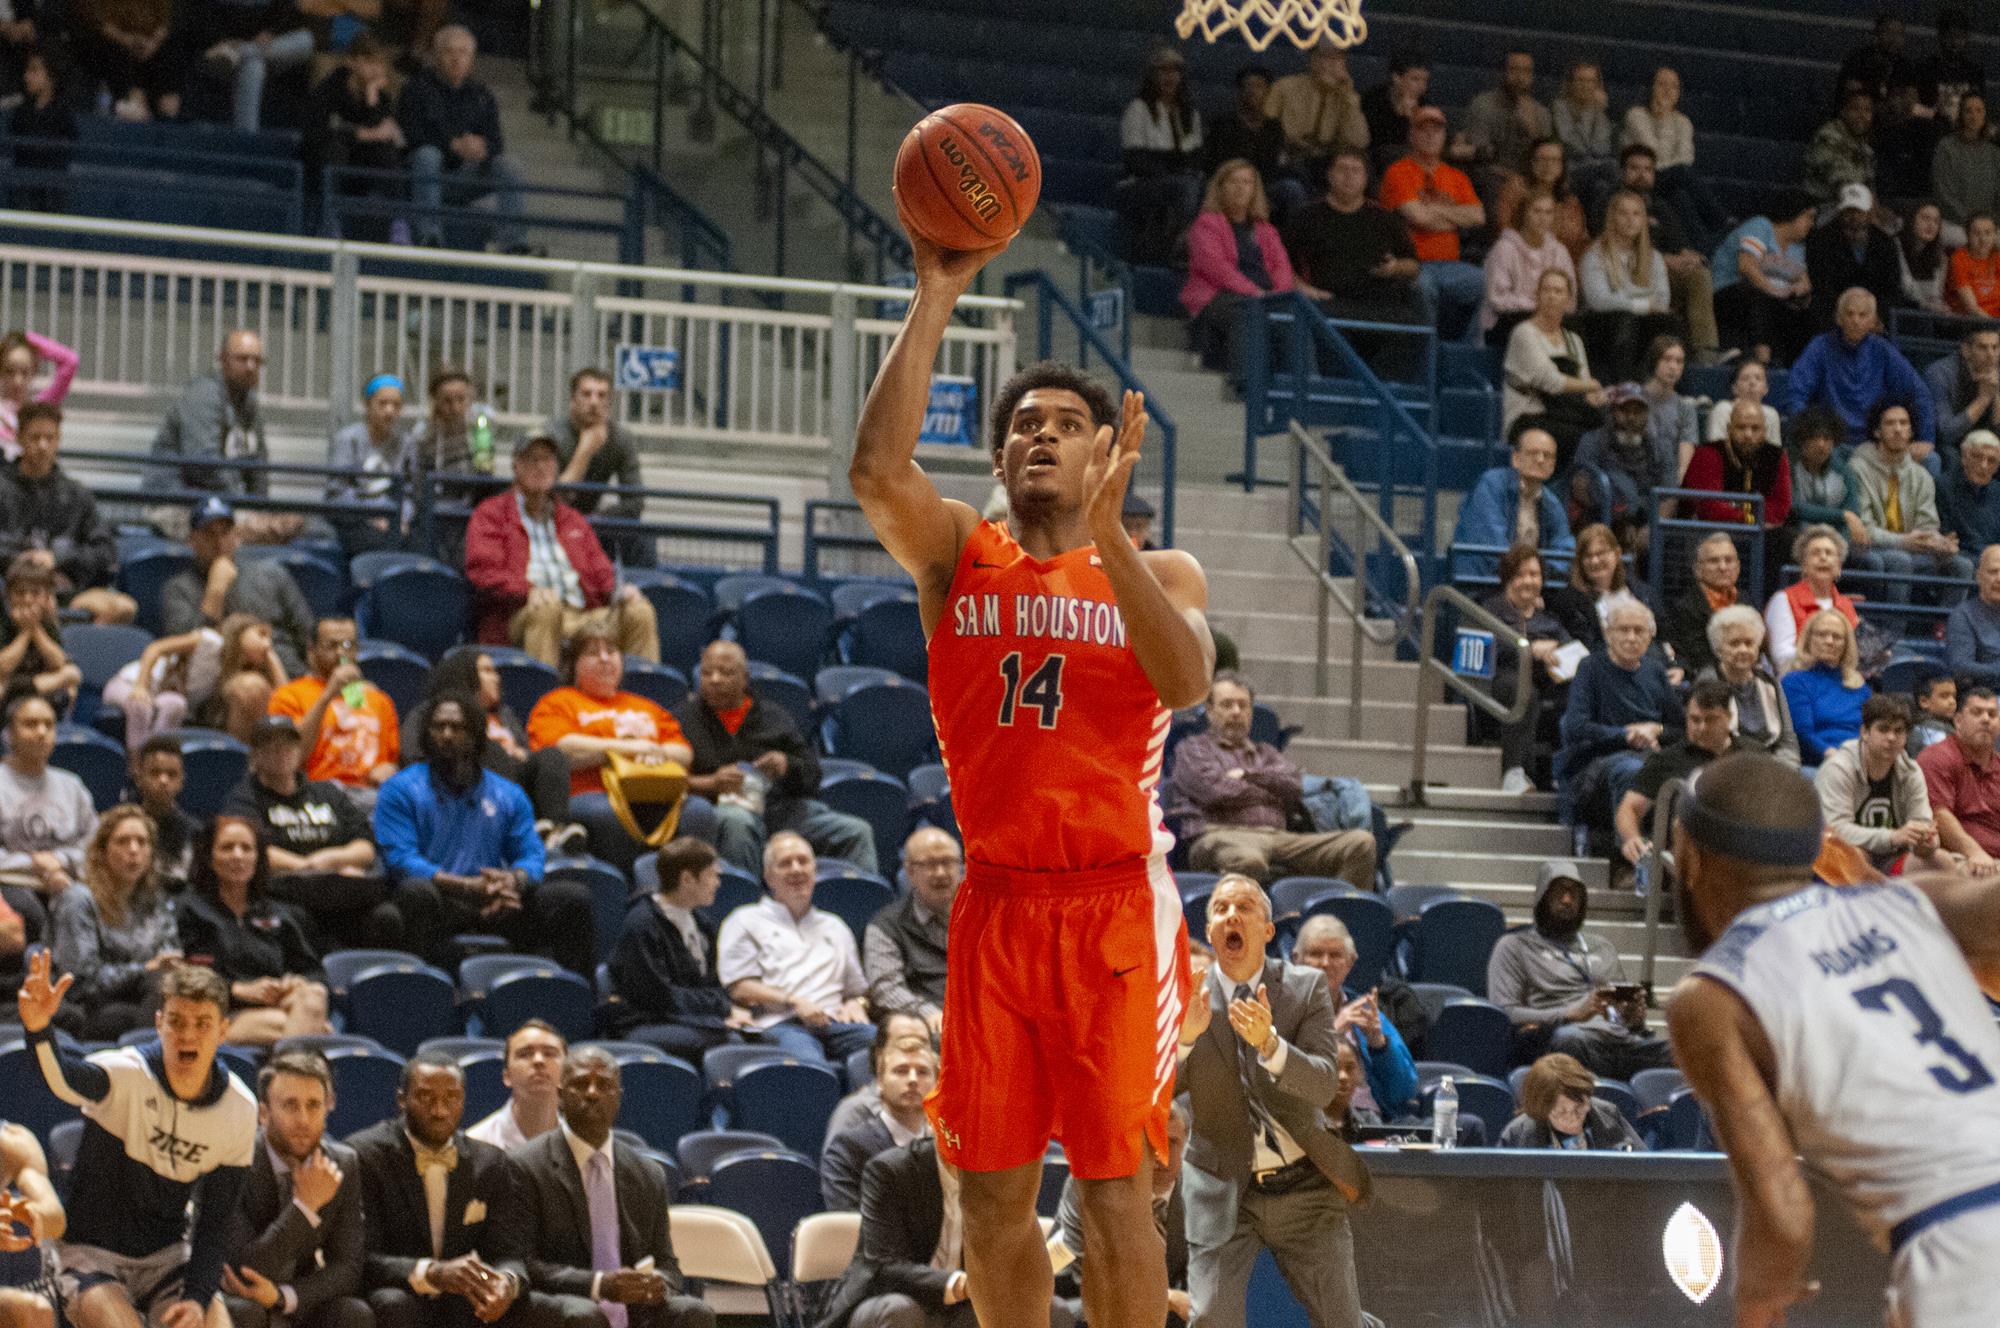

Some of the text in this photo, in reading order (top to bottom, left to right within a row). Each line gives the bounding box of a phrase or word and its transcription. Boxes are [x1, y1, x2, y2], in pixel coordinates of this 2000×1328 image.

[938, 137, 1003, 223] Wilson
[978, 121, 1029, 182] NCAA
[954, 594, 1126, 648] SAM HOUSTON
[1460, 636, 1485, 671] 110
[998, 651, 1065, 730] 14
[1850, 977, 1996, 1094] 3
